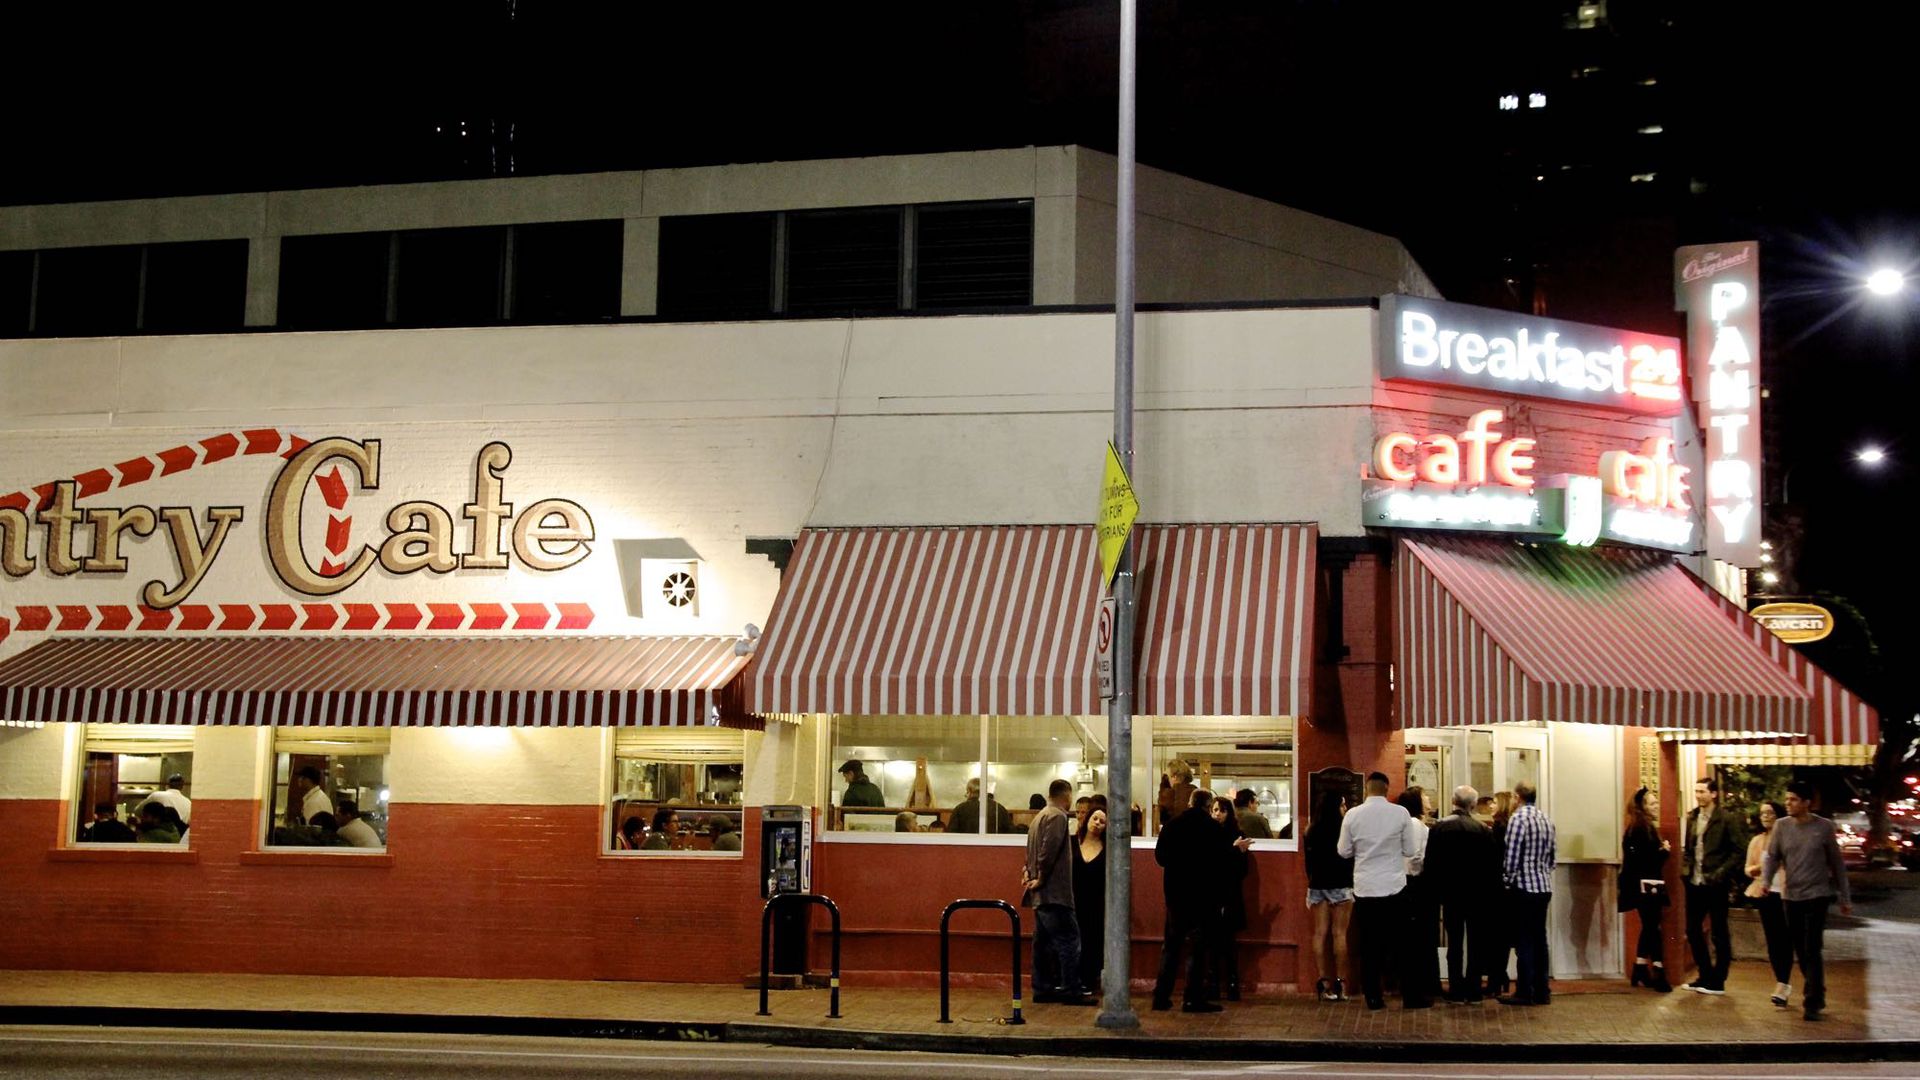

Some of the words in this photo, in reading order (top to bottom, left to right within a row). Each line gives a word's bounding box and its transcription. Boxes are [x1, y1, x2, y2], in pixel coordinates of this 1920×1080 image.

[1681, 247, 1750, 280] Original
[1402, 310, 1627, 393] Breakfast
[1630, 344, 1680, 387] 24
[1374, 409, 1537, 487] cafe
[1708, 282, 1753, 543] PANTRY
[0, 480, 244, 610] ntry
[266, 437, 595, 596] Cafe
